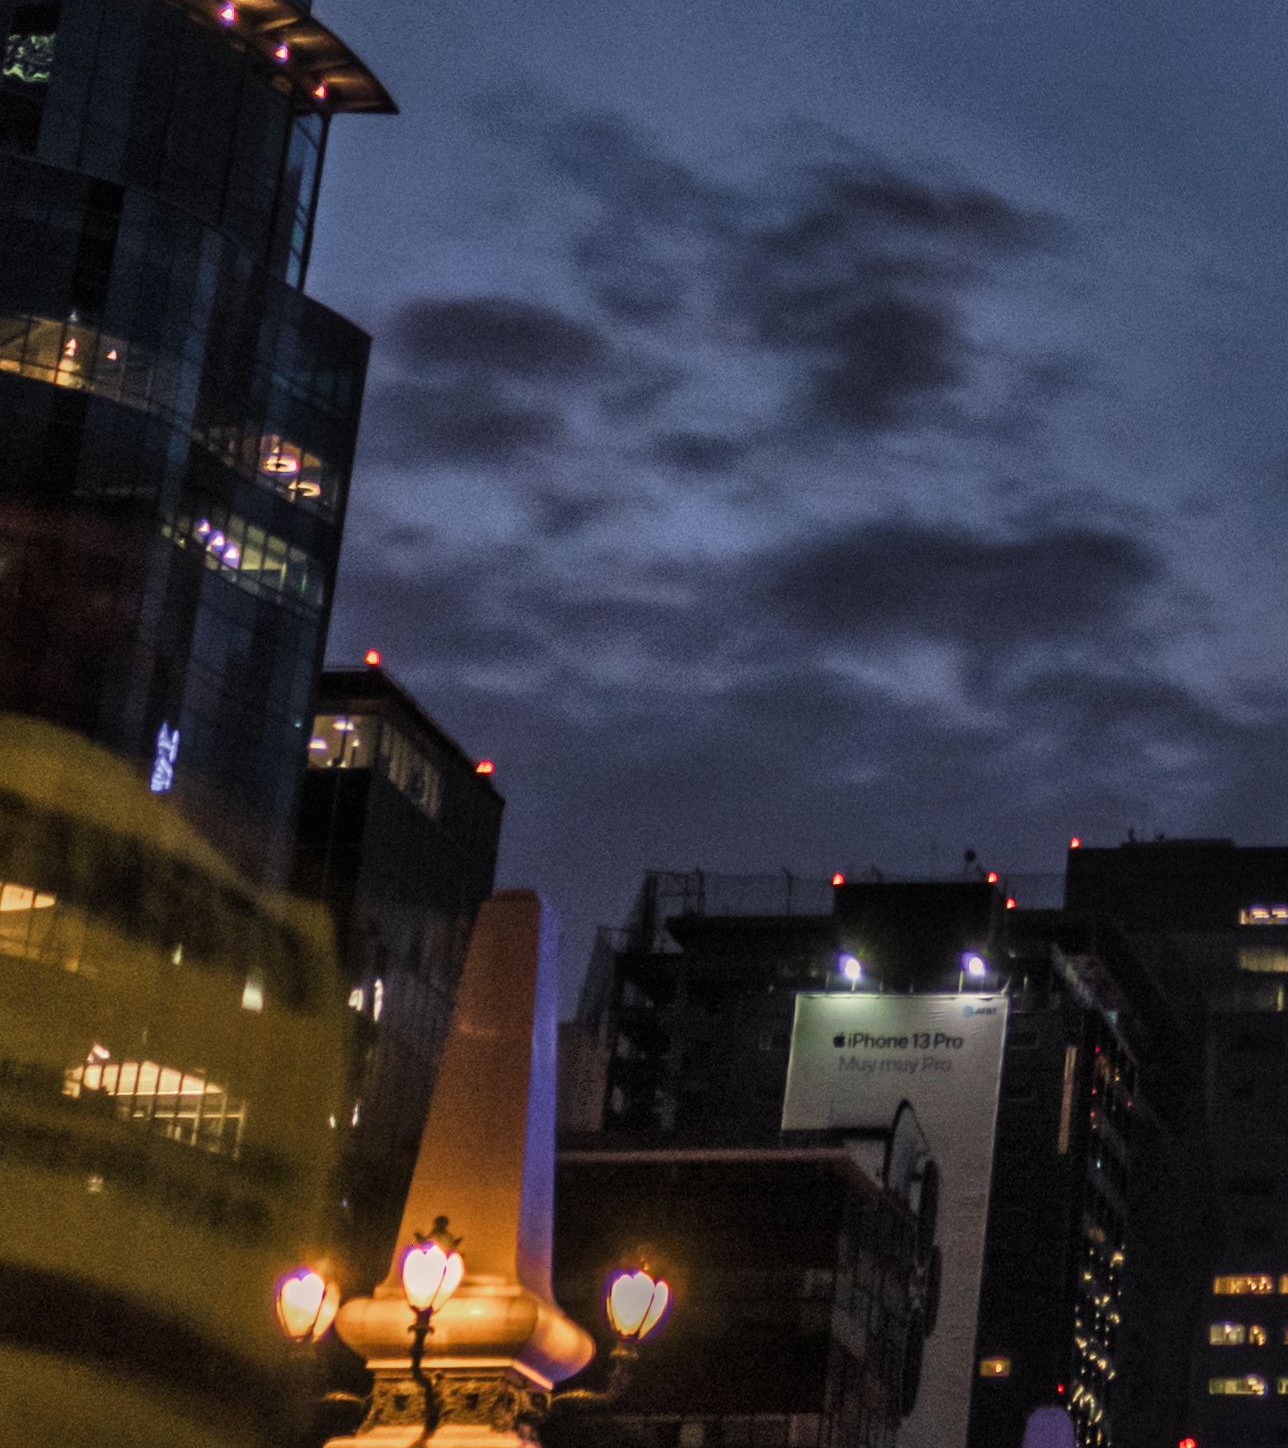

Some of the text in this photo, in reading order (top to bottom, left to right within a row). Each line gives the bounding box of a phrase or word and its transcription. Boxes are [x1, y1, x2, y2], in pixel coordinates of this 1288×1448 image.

[847, 1032, 964, 1049] iPhone 13 Pro
[838, 1055, 953, 1075] Muy muy Pro
